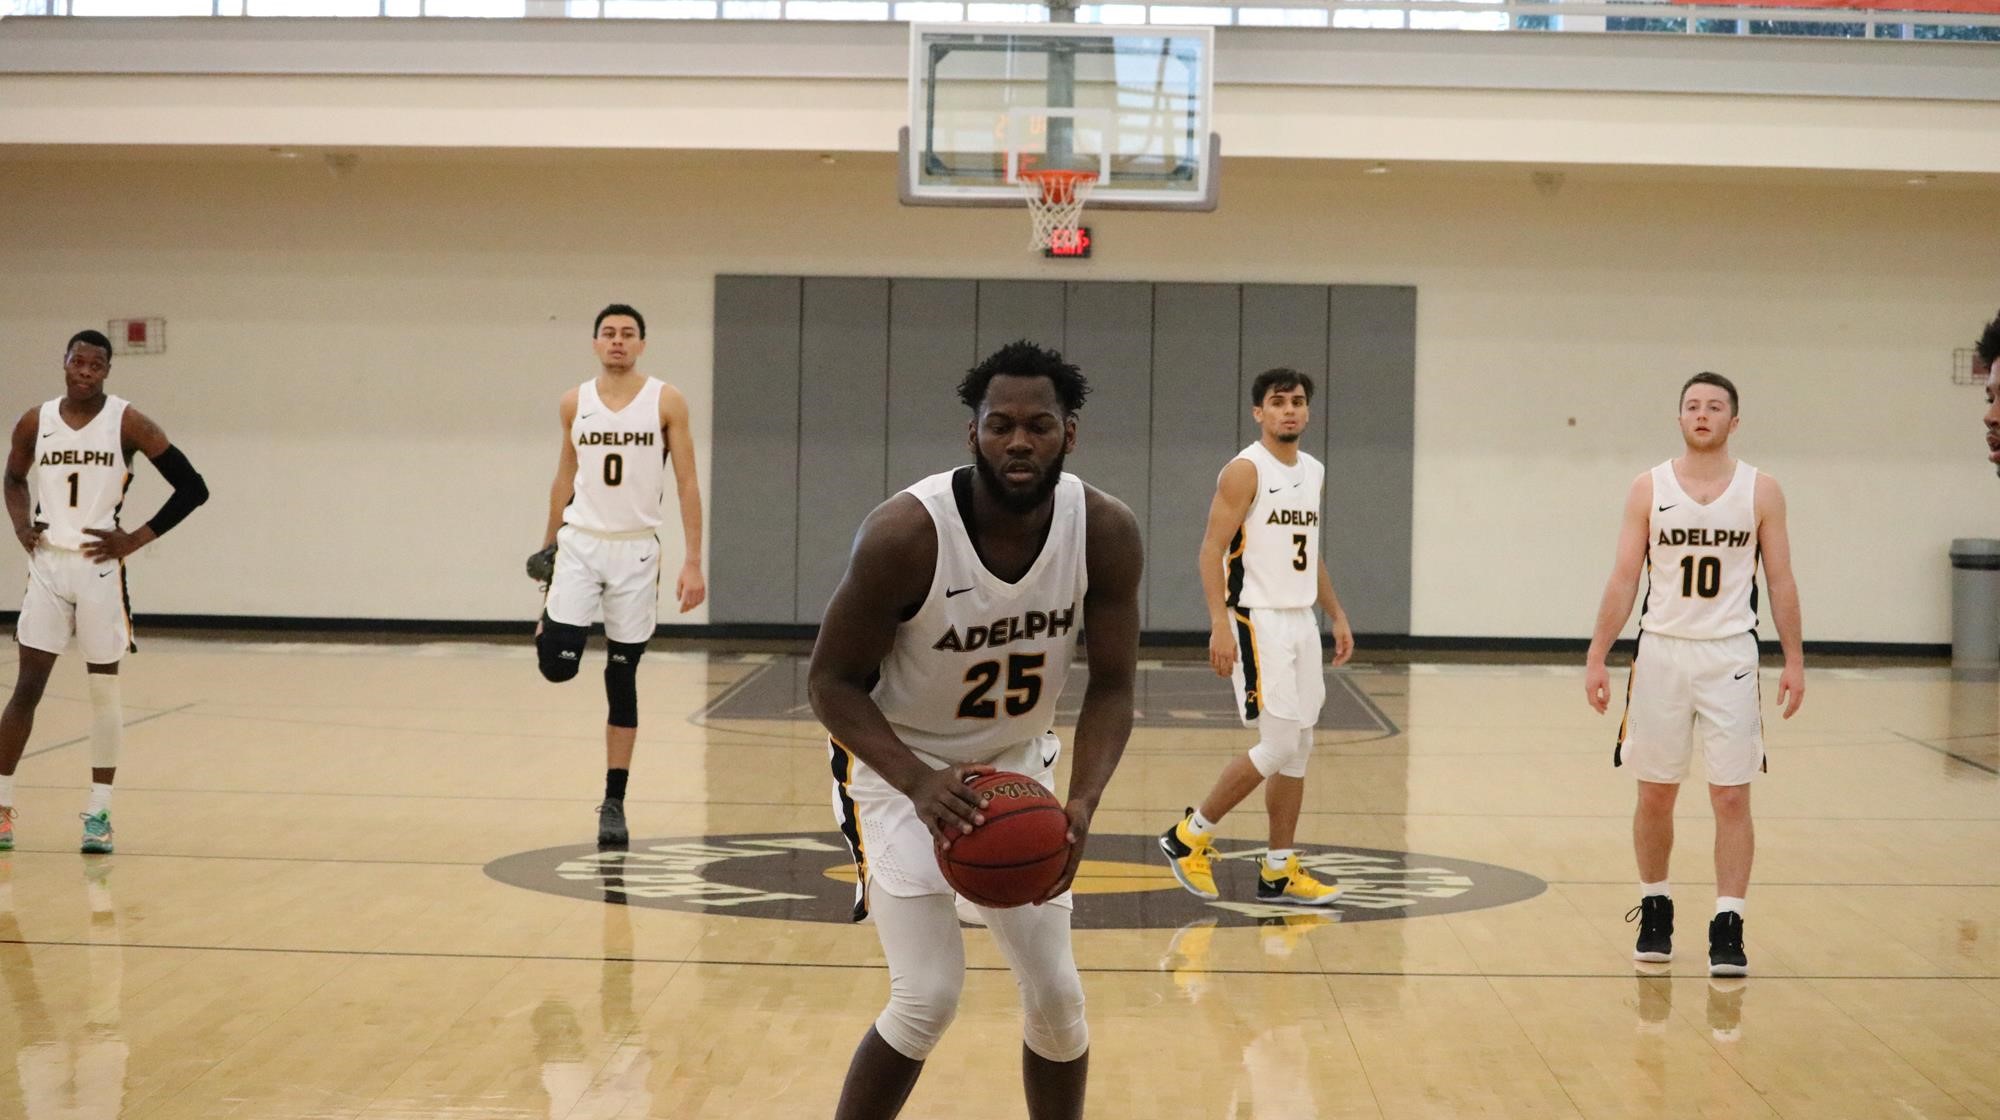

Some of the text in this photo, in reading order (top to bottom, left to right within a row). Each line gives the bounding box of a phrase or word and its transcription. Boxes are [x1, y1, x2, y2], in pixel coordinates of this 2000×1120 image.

[579, 431, 654, 446] ADELPHI
[40, 450, 115, 467] ADELPHI
[603, 452, 623, 487] 0
[66, 471, 79, 509] 1
[1292, 533, 1308, 572] 3
[1658, 528, 1751, 547] ADELPHI
[1679, 555, 1721, 598] 10
[955, 652, 1047, 719] 25
